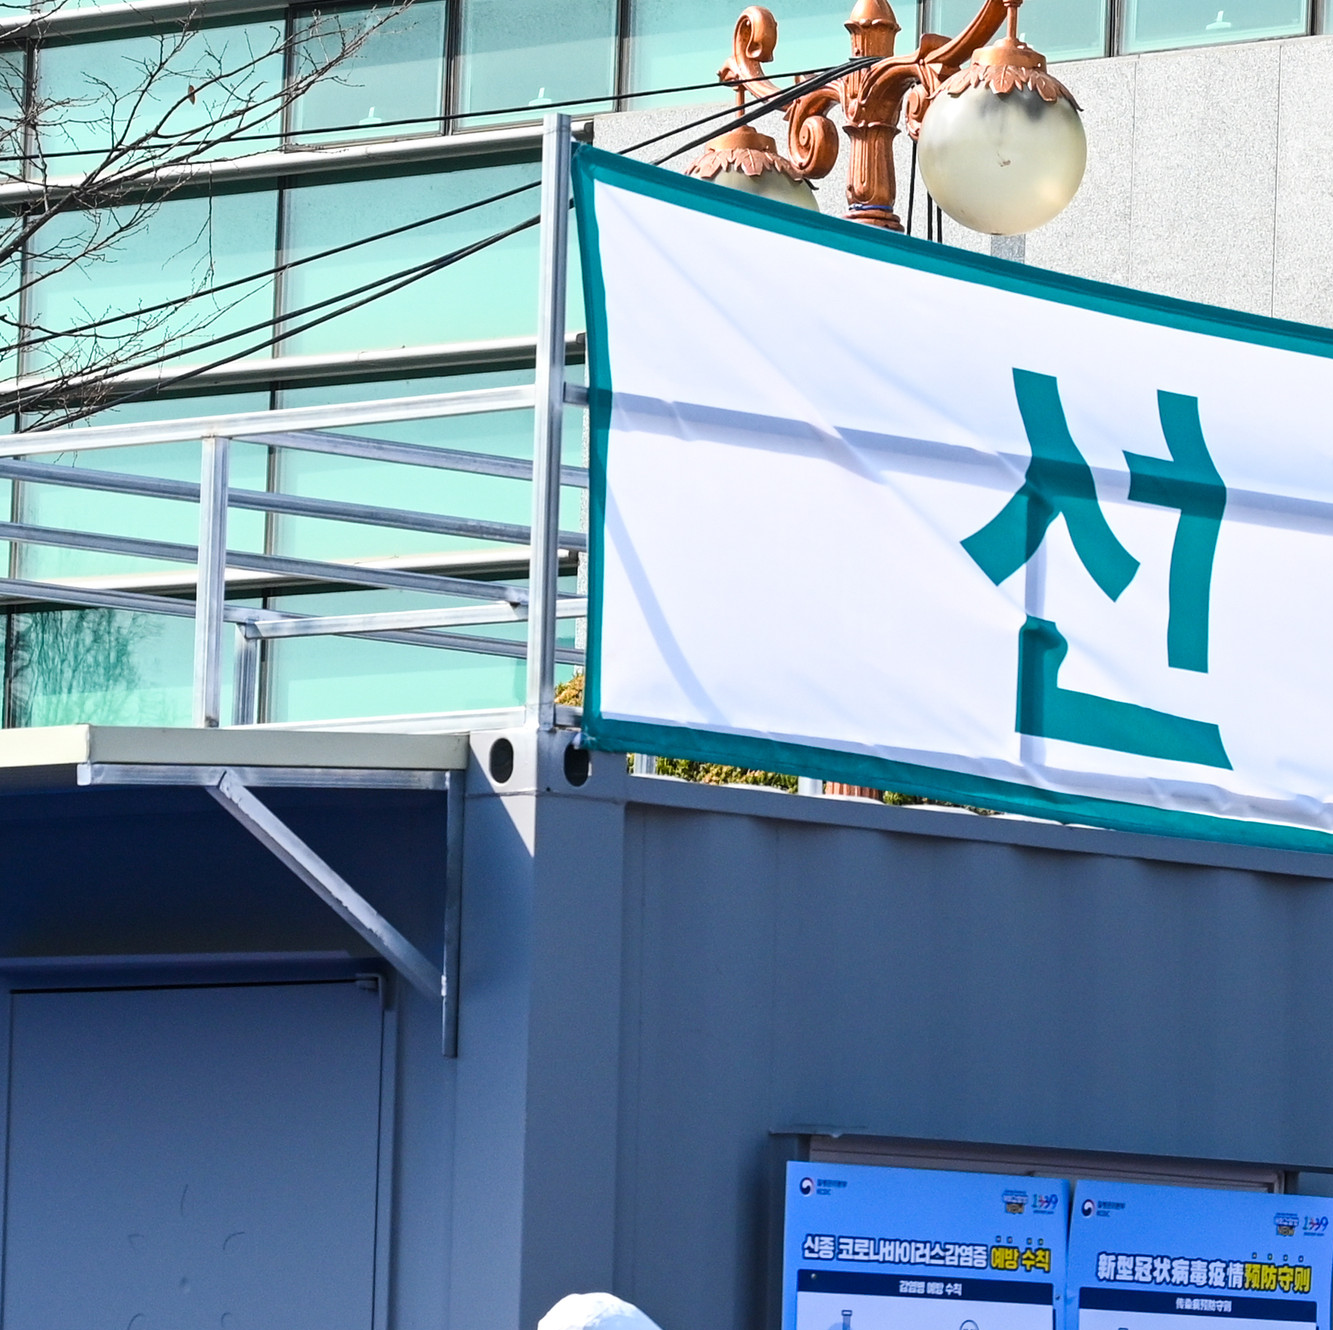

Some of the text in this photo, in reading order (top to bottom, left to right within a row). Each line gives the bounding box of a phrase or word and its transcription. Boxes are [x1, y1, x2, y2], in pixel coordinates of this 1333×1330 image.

[803, 1235, 1051, 1272] 신종 코로나바이러스감염증 예방 수칙
[927, 1281, 944, 1295] 예방
[945, 1282, 962, 1296] 수칙
[1097, 1253, 1312, 1293] 新型冠状病毒疫情预防守则
